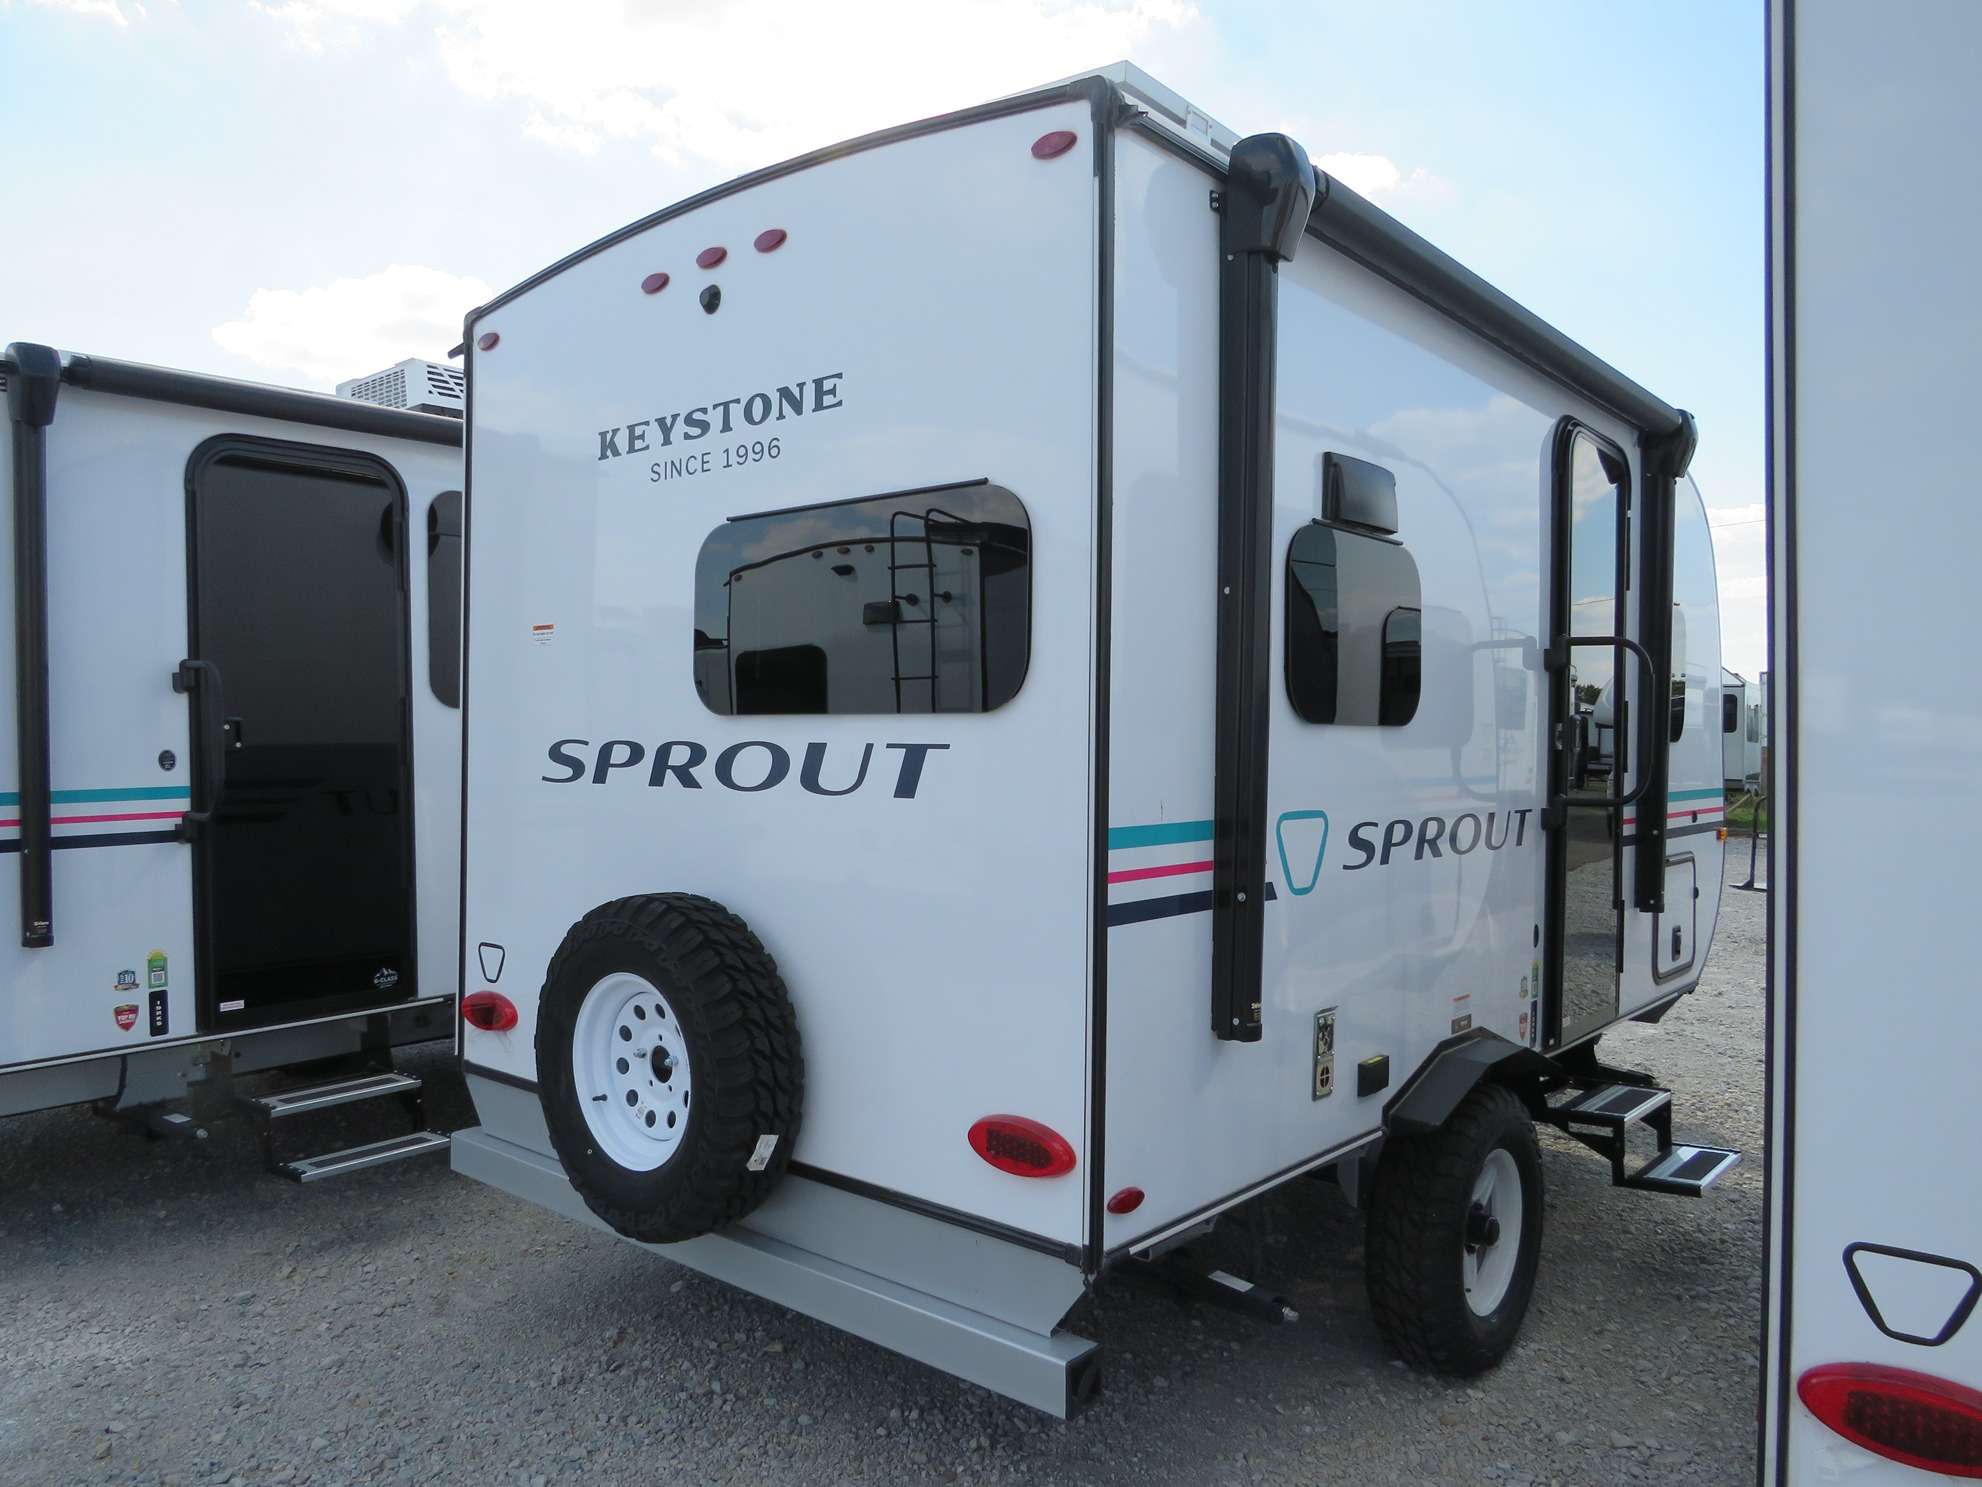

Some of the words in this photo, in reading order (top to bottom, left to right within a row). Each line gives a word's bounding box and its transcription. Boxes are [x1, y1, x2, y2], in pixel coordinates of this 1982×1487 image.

[597, 372, 845, 461] KEYSTONE
[650, 453, 712, 483] SINCE
[722, 437, 782, 470] 1996
[541, 738, 951, 800] SPROUT
[1342, 808, 1533, 871] SPROUT
